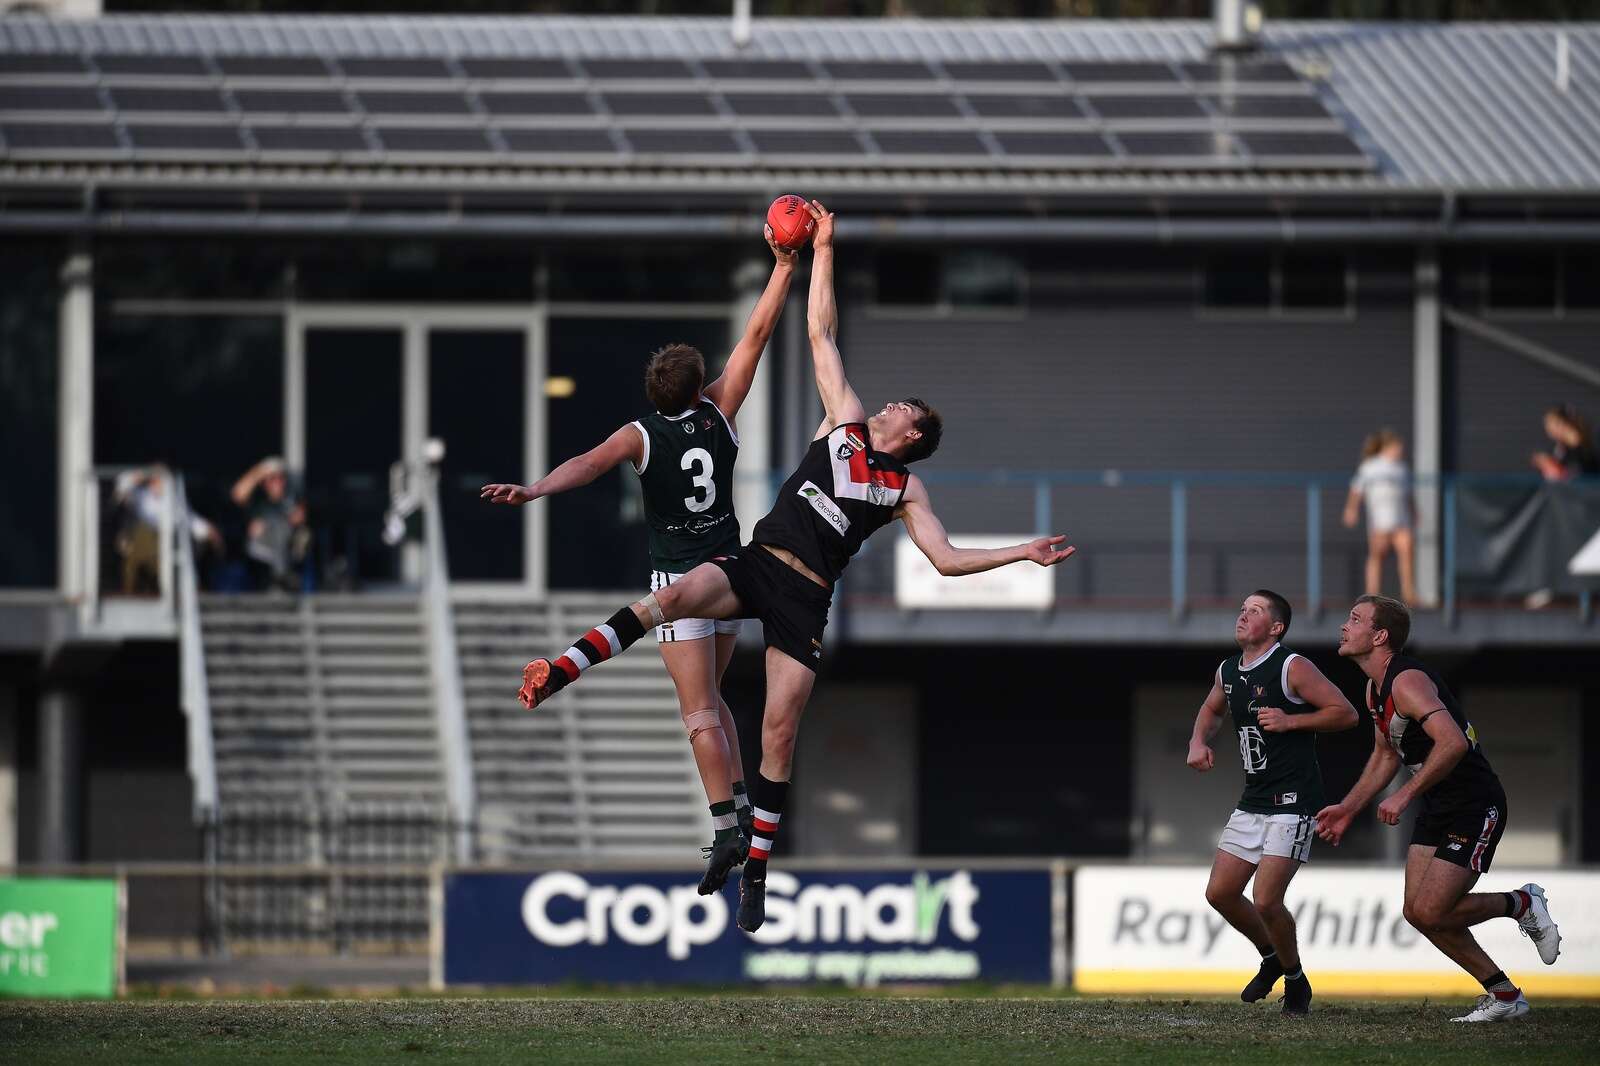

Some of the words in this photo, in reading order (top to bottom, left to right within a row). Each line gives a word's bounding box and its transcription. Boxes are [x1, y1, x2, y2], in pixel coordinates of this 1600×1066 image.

[681, 447, 716, 513] 3
[522, 870, 729, 961] Crop
[742, 868, 981, 945] Smart
[1113, 895, 1227, 955] Ray
[1293, 894, 1422, 948] hite
